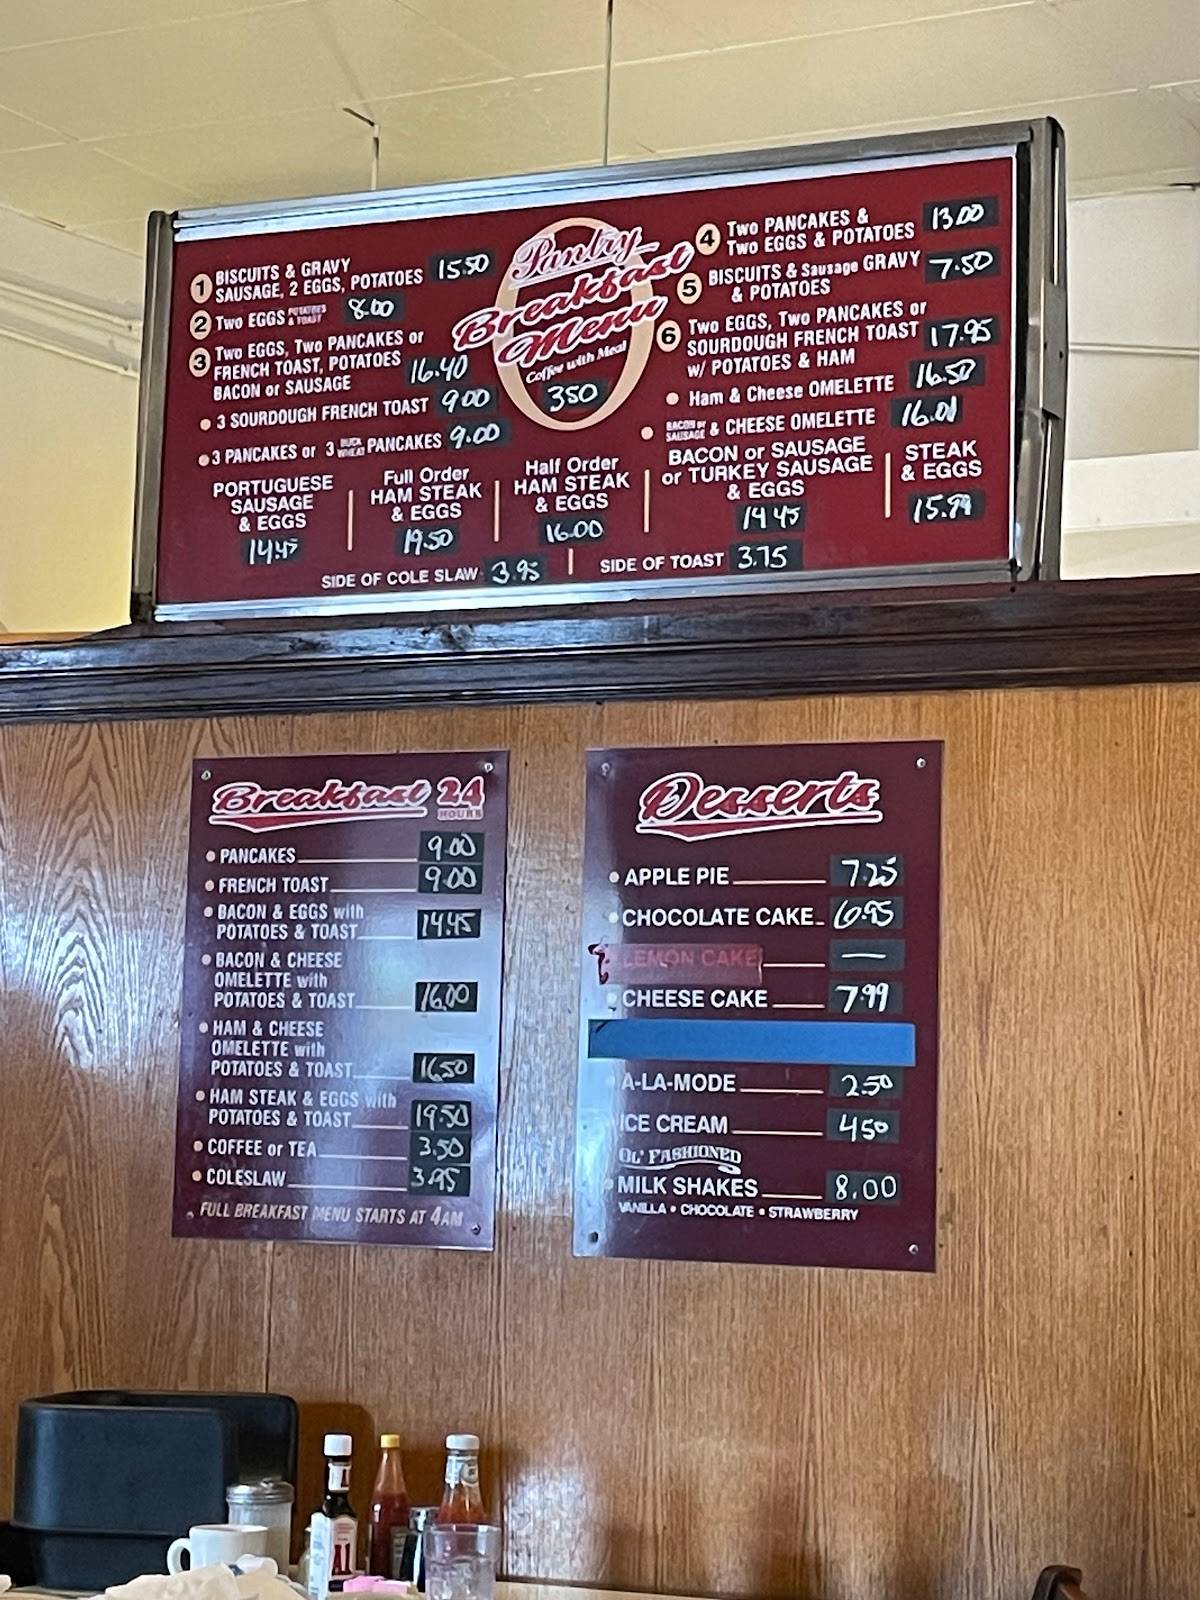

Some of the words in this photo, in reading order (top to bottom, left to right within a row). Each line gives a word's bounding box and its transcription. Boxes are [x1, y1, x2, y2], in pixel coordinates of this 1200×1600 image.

[727, 221, 758, 237] Two
[764, 210, 850, 233] PANCAKES
[857, 208, 868, 224] &
[727, 241, 758, 256] Two
[764, 235, 807, 252] EGGS
[814, 232, 826, 248] &
[833, 222, 915, 246] POTATOES
[215, 265, 279, 285] BISCUITS
[286, 264, 295, 278] &
[301, 258, 350, 276] GRAVY
[708, 264, 782, 286] BISCUITS
[786, 262, 797, 278] &
[801, 260, 858, 278] Sausage
[863, 251, 921, 270] GRAVY
[215, 282, 285, 303] SAUSAGE,
[289, 281, 298, 296] 2
[303, 278, 345, 295] EGGS,
[351, 270, 423, 290] POTATOES
[452, 241, 695, 351] Breakfast
[215, 315, 242, 330] Two
[248, 312, 285, 327] EGGS
[688, 319, 718, 335] Two
[725, 314, 772, 332] EGGS,
[779, 311, 810, 327] Two
[816, 301, 903, 324] PANCAKES
[910, 301, 927, 316] or
[497, 296, 668, 367] Menu
[687, 336, 787, 356] SOURDOUGH
[794, 327, 859, 348] FRENCH
[866, 322, 919, 340] TOAST
[215, 346, 242, 361] Two
[247, 341, 288, 359] EGGS,
[294, 340, 322, 354] Two
[328, 332, 404, 350] PANCAKES
[409, 331, 424, 344] or
[214, 362, 270, 380] FRENCH
[275, 358, 323, 376] TOAST,
[329, 351, 401, 372] POTATOES
[526, 363, 563, 383] Coffee
[567, 352, 594, 370] with
[596, 341, 627, 360] Meal
[688, 358, 706, 378] w/
[711, 355, 791, 376] POTATOES
[798, 353, 809, 368] &
[817, 348, 855, 366] HAM
[213, 383, 260, 400] BACON
[266, 384, 280, 396] or
[286, 376, 351, 395] SAUSAGE
[689, 390, 723, 406] Ham
[729, 388, 740, 403] &
[747, 382, 803, 401] Cheese
[809, 375, 894, 397] OMELETTE
[217, 415, 225, 429] 3
[230, 406, 316, 427] SOURDOUGH
[322, 402, 377, 420] FRENCH
[383, 398, 429, 415] TOAST
[710, 419, 719, 436] &
[726, 416, 785, 434] CHEESE
[791, 408, 875, 431] OMELETTE
[212, 452, 220, 465] 3
[225, 444, 297, 463] PANCAKES
[302, 447, 316, 458] or
[326, 442, 335, 456] 3
[368, 433, 442, 452] PANCAKES
[669, 447, 738, 466] BACON
[745, 445, 765, 460] or
[771, 437, 865, 458] SAUSAGE
[906, 440, 977, 461] STEAK
[384, 469, 413, 486] Full
[420, 466, 469, 482] Order
[526, 458, 560, 476] Half
[567, 457, 618, 473] Order
[662, 470, 682, 485] or
[688, 462, 769, 483] TURKEY
[777, 455, 873, 476] SAUSAGE
[213, 475, 333, 497] PORTUGUESE
[371, 487, 412, 504] HAM
[420, 482, 482, 500] STEAK
[514, 477, 557, 495] HAM
[565, 472, 630, 492] STEAK
[231, 495, 313, 515] SAUSAGE
[600, 558, 637, 573] SIDE
[643, 556, 664, 570] OF
[670, 553, 724, 568] TOAST
[322, 574, 355, 589] SIDE
[361, 572, 381, 586] OF
[386, 570, 429, 585] COLE
[434, 567, 478, 582] SLAW
[212, 779, 431, 814] Breakfast
[437, 776, 485, 806] 24
[639, 771, 880, 822] Desserts
[220, 848, 296, 864] PANCAKES
[219, 877, 276, 893] FRENCH
[282, 877, 329, 892] TOAST
[625, 868, 689, 885] APPLE
[697, 867, 729, 884] PIE
[622, 908, 749, 926] CHOCOLATE
[756, 908, 814, 926] CAKE
[217, 925, 288, 940] POTATOES
[294, 925, 304, 939] &
[312, 924, 358, 939] TOAST
[214, 992, 285, 1008] POTATOES
[292, 993, 302, 1008] &
[309, 993, 356, 1008] TOAST
[622, 990, 704, 1008] CHEESE
[708, 989, 767, 1008] CAKE
[621, 1073, 736, 1092] A-LA-MODE
[619, 1115, 650, 1132] ICE
[656, 1115, 728, 1134] CREAM
[208, 1139, 262, 1155] COFFEE
[268, 1143, 283, 1156] or
[288, 1141, 317, 1157] TEA
[649, 1144, 742, 1164] FASHIONED
[207, 1169, 285, 1186] COLESLAW
[618, 1177, 666, 1195] MILK
[673, 1178, 758, 1197] SHAKES
[200, 1202, 231, 1217] FULL
[234, 1203, 306, 1219] BREAKFAST
[312, 1207, 350, 1221] MENU
[356, 1208, 405, 1223] STARTS
[410, 1210, 426, 1224] AT
[430, 1207, 463, 1226] 4AM
[619, 1203, 666, 1214] VANILLA
[680, 1205, 754, 1217] CHOCOLATE
[769, 1206, 858, 1220] STRAWBERRY
